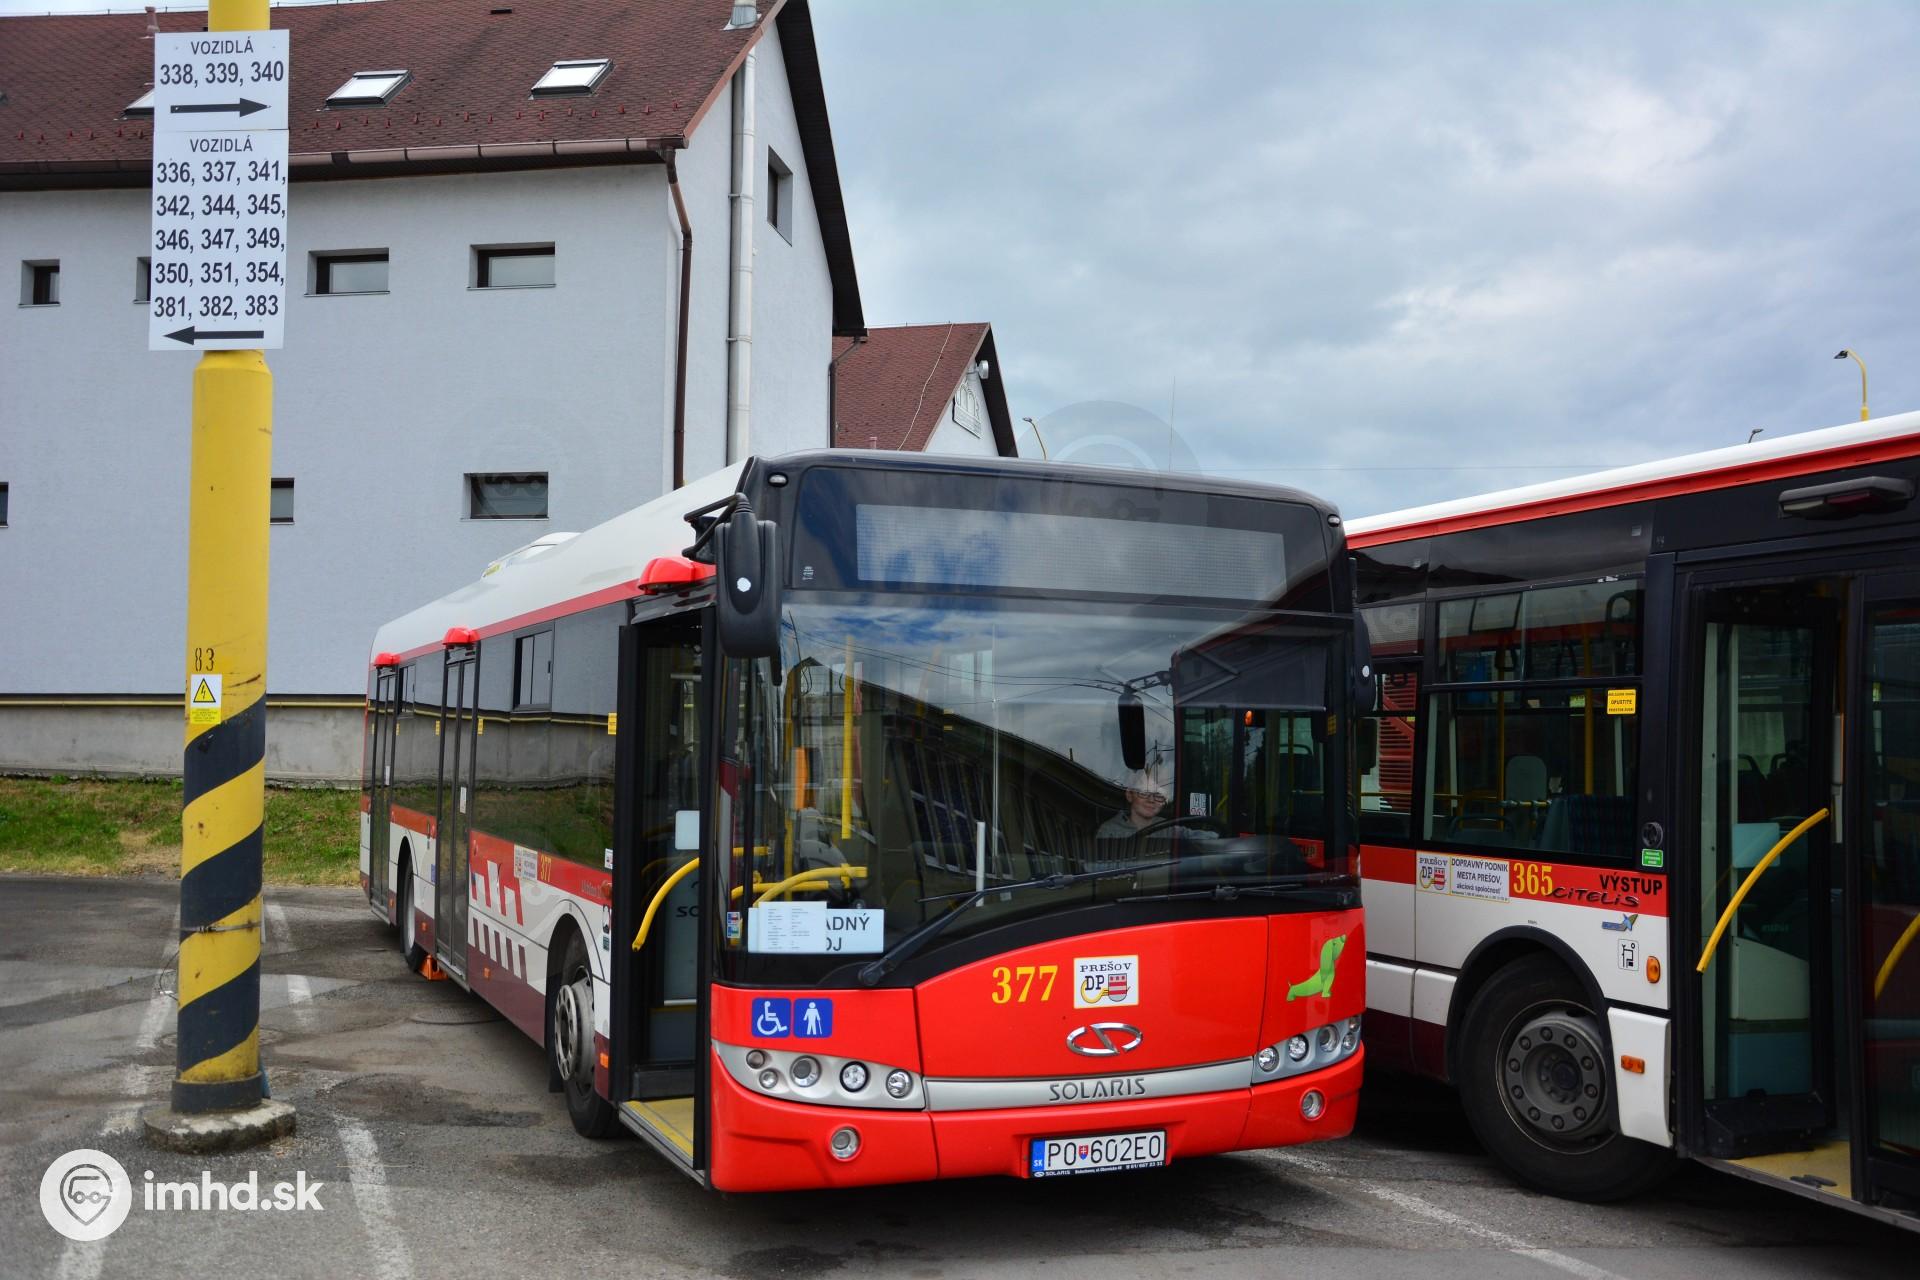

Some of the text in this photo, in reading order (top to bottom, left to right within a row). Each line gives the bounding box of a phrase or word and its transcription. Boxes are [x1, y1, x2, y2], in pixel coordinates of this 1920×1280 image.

[191, 37, 253, 54] VOZIDLÁ
[160, 61, 284, 88] 338, 339, 340
[190, 135, 253, 152] VOZIDLÁ
[157, 160, 286, 185] 336, 337, 341,
[156, 193, 286, 220] 342, 344, 345,
[155, 227, 285, 253] 346, 347, 349,
[155, 261, 284, 287] 350, 351, 354,
[154, 295, 279, 320] 381, 382, 383
[195, 648, 215, 672] 83
[541, 854, 552, 882] 377
[1420, 857, 1448, 867] PREŠOV
[1422, 866, 1433, 879] DP
[1451, 858, 1508, 872] DOPRAVNÝ PODNIK
[1456, 871, 1502, 885] MESTA PREŠOV,
[1513, 862, 1553, 896] 365
[1600, 872, 1663, 896] VÝSTUP
[1080, 961, 1132, 973] PREŠOV
[992, 965, 1058, 1004] 377
[1085, 975, 1105, 990] DP
[1049, 1078, 1145, 1101] SOLARIS
[1033, 1159, 1043, 1167] SK
[1048, 1142, 1077, 1167] PO
